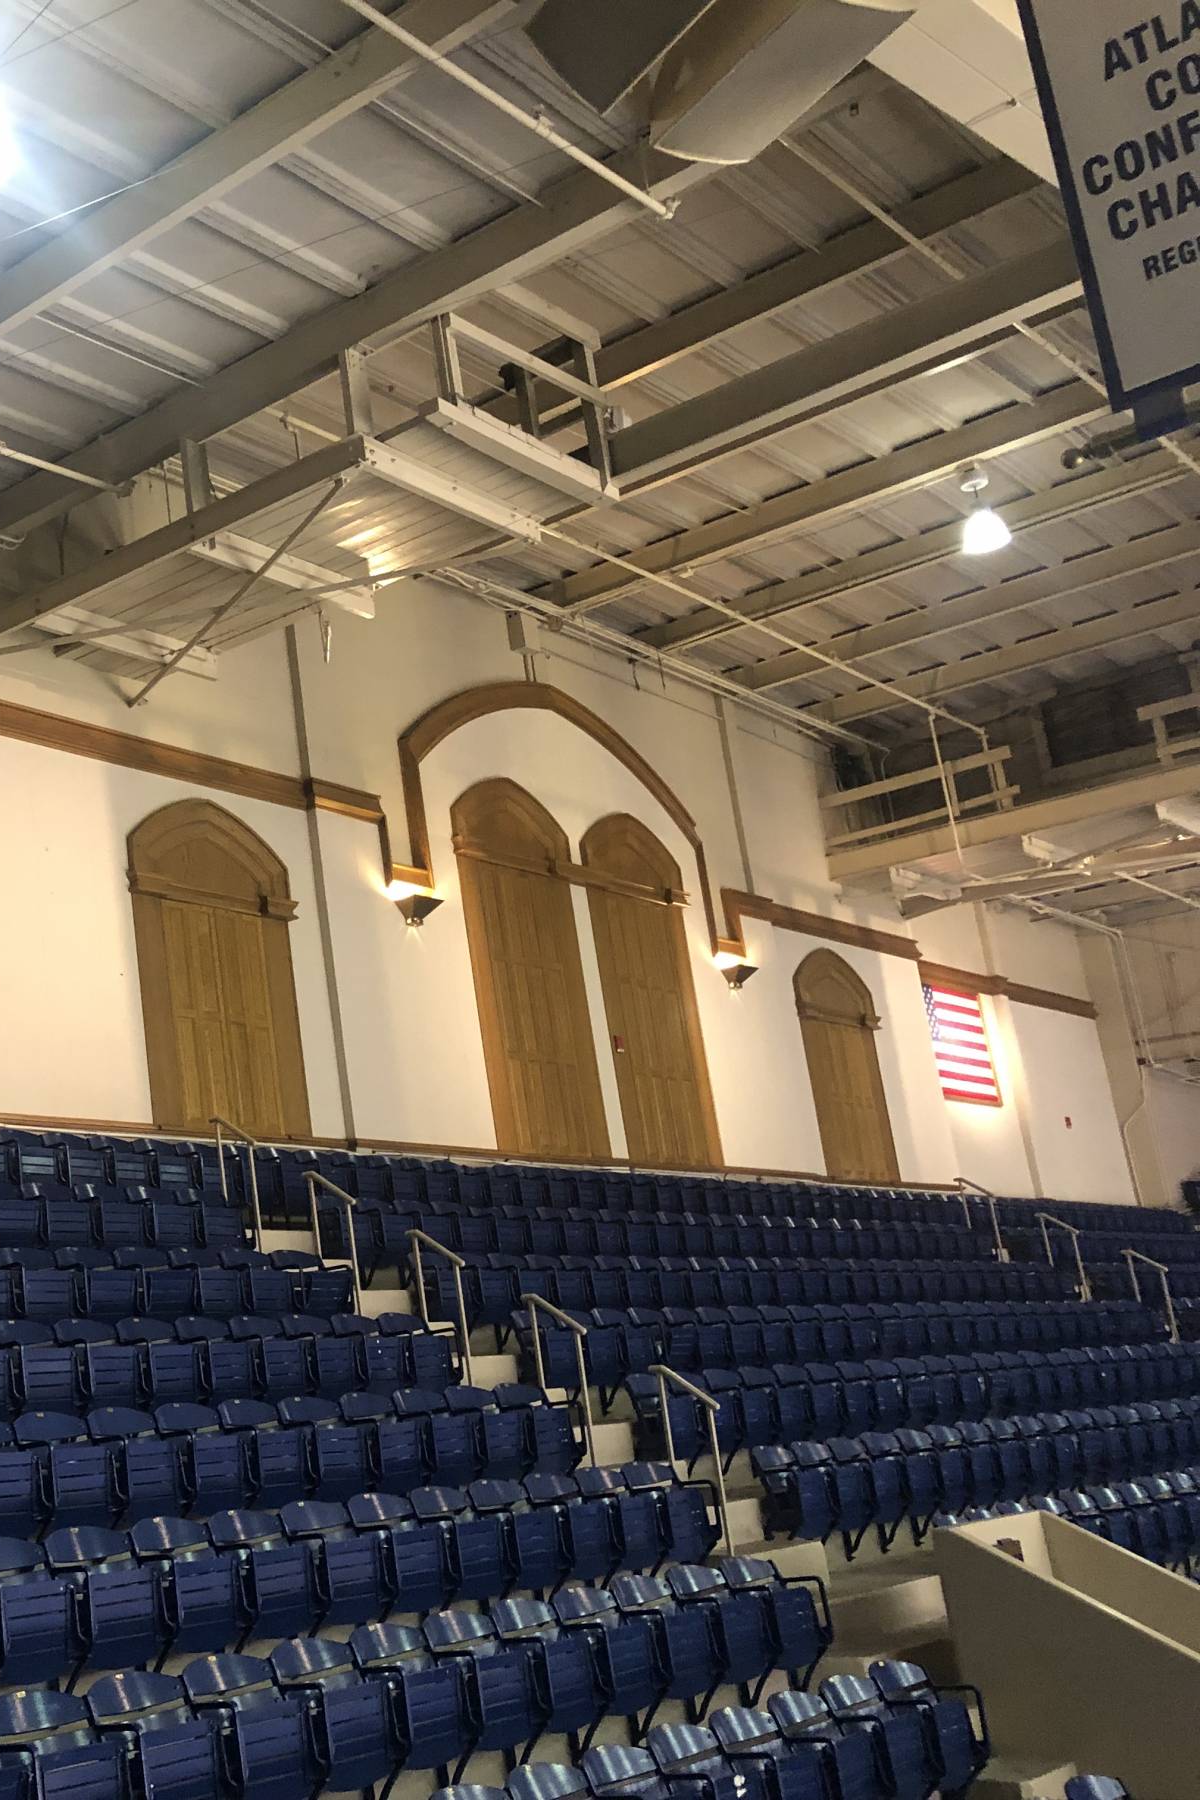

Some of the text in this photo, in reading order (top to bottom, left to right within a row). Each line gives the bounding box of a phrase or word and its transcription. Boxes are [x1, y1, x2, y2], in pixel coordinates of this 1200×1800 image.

[1083, 110, 1200, 195] CONF
[1107, 171, 1200, 240] CHA
[1143, 235, 1200, 281] REG
